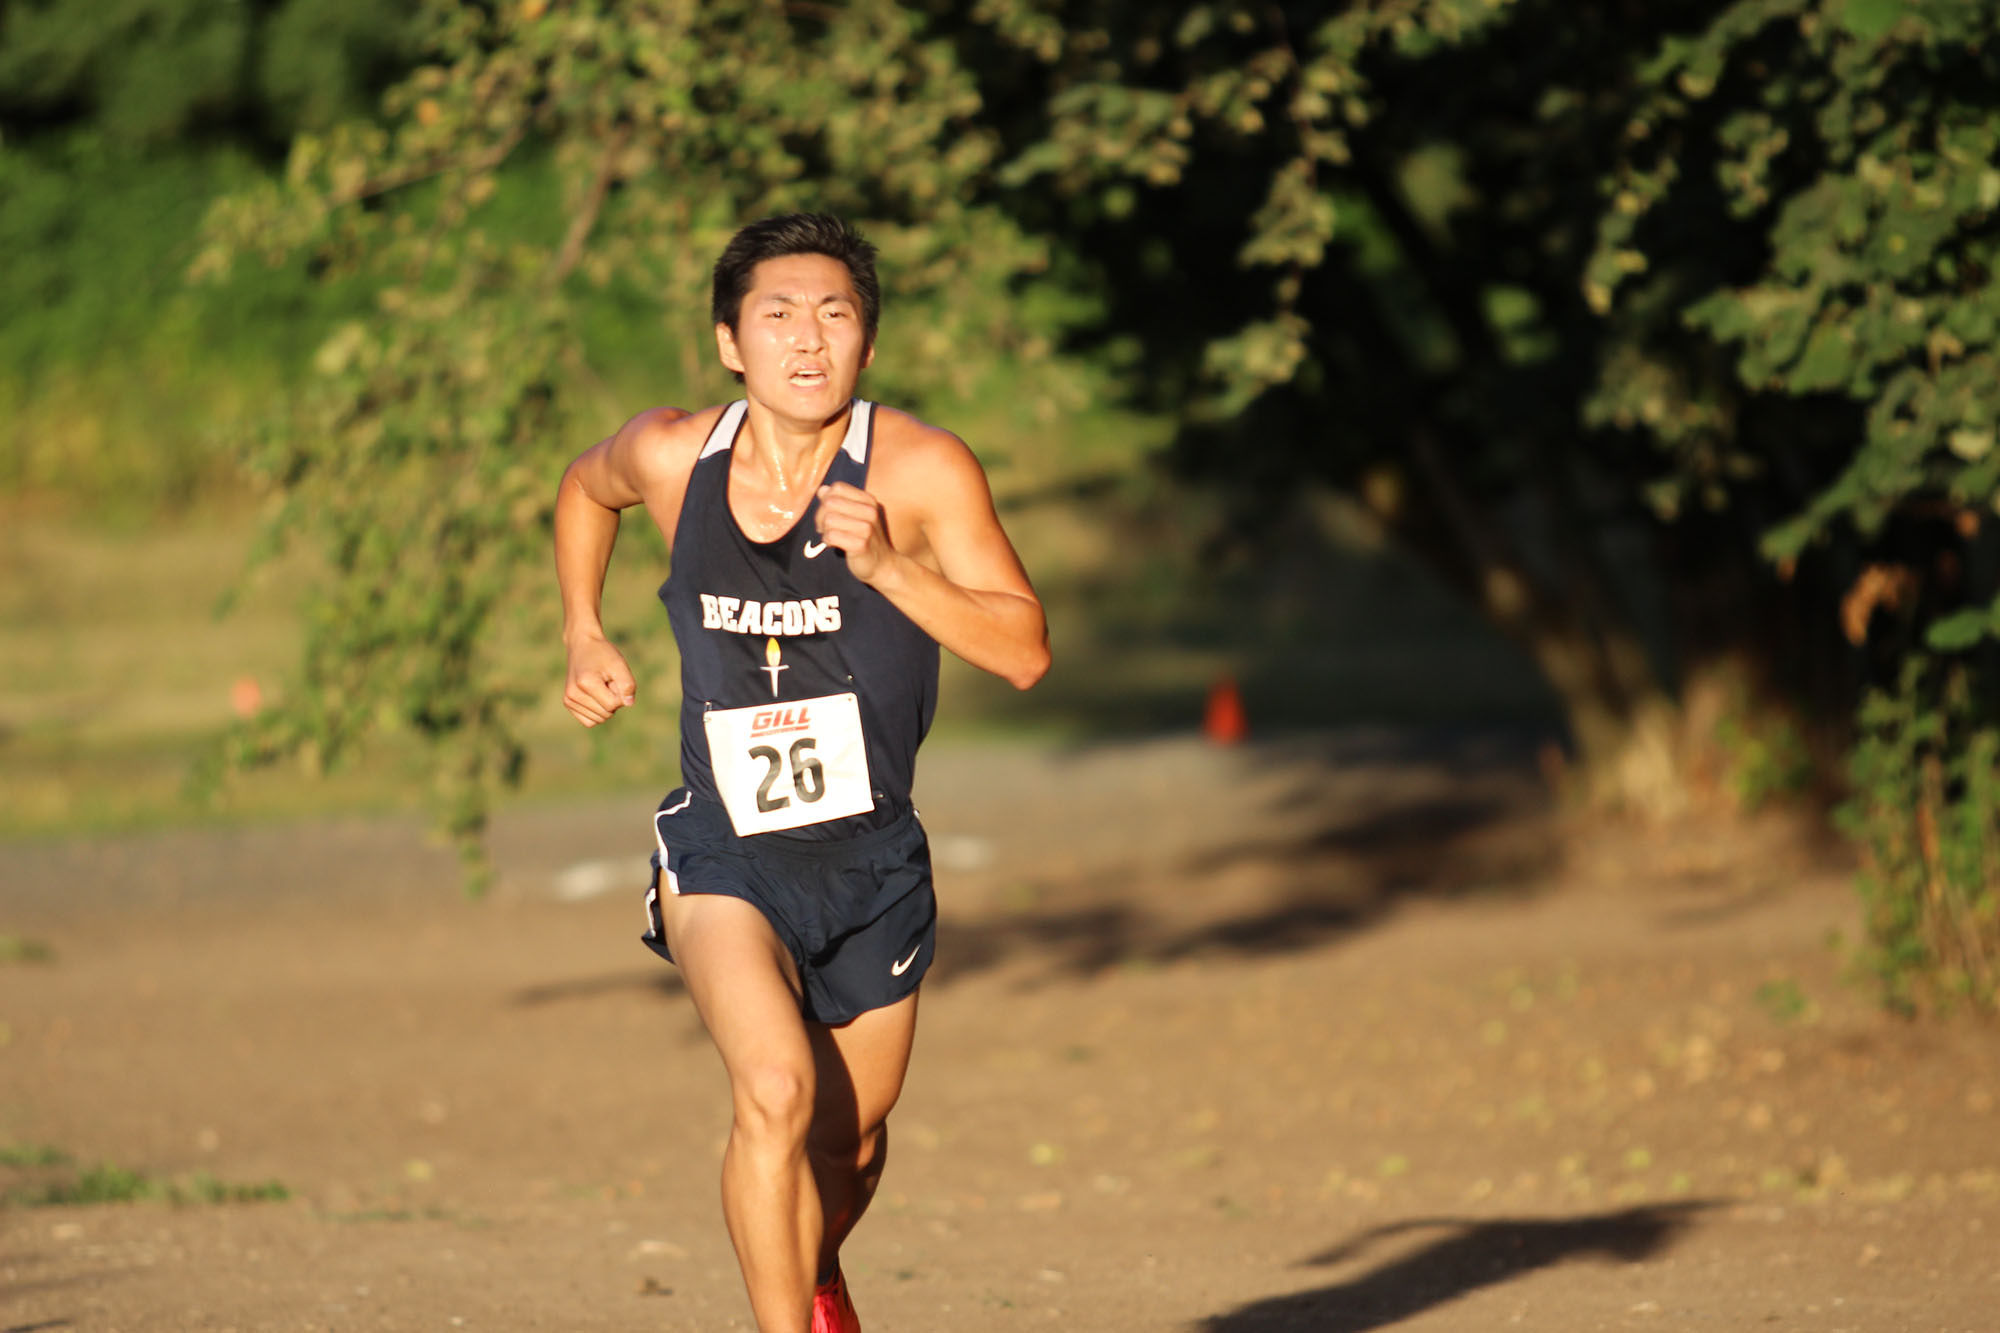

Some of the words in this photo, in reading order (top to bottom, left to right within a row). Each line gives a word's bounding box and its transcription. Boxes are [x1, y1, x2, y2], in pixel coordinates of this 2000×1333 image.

[700, 593, 842, 636] BEACONS
[752, 706, 811, 730] GILL
[748, 737, 825, 813] 26
